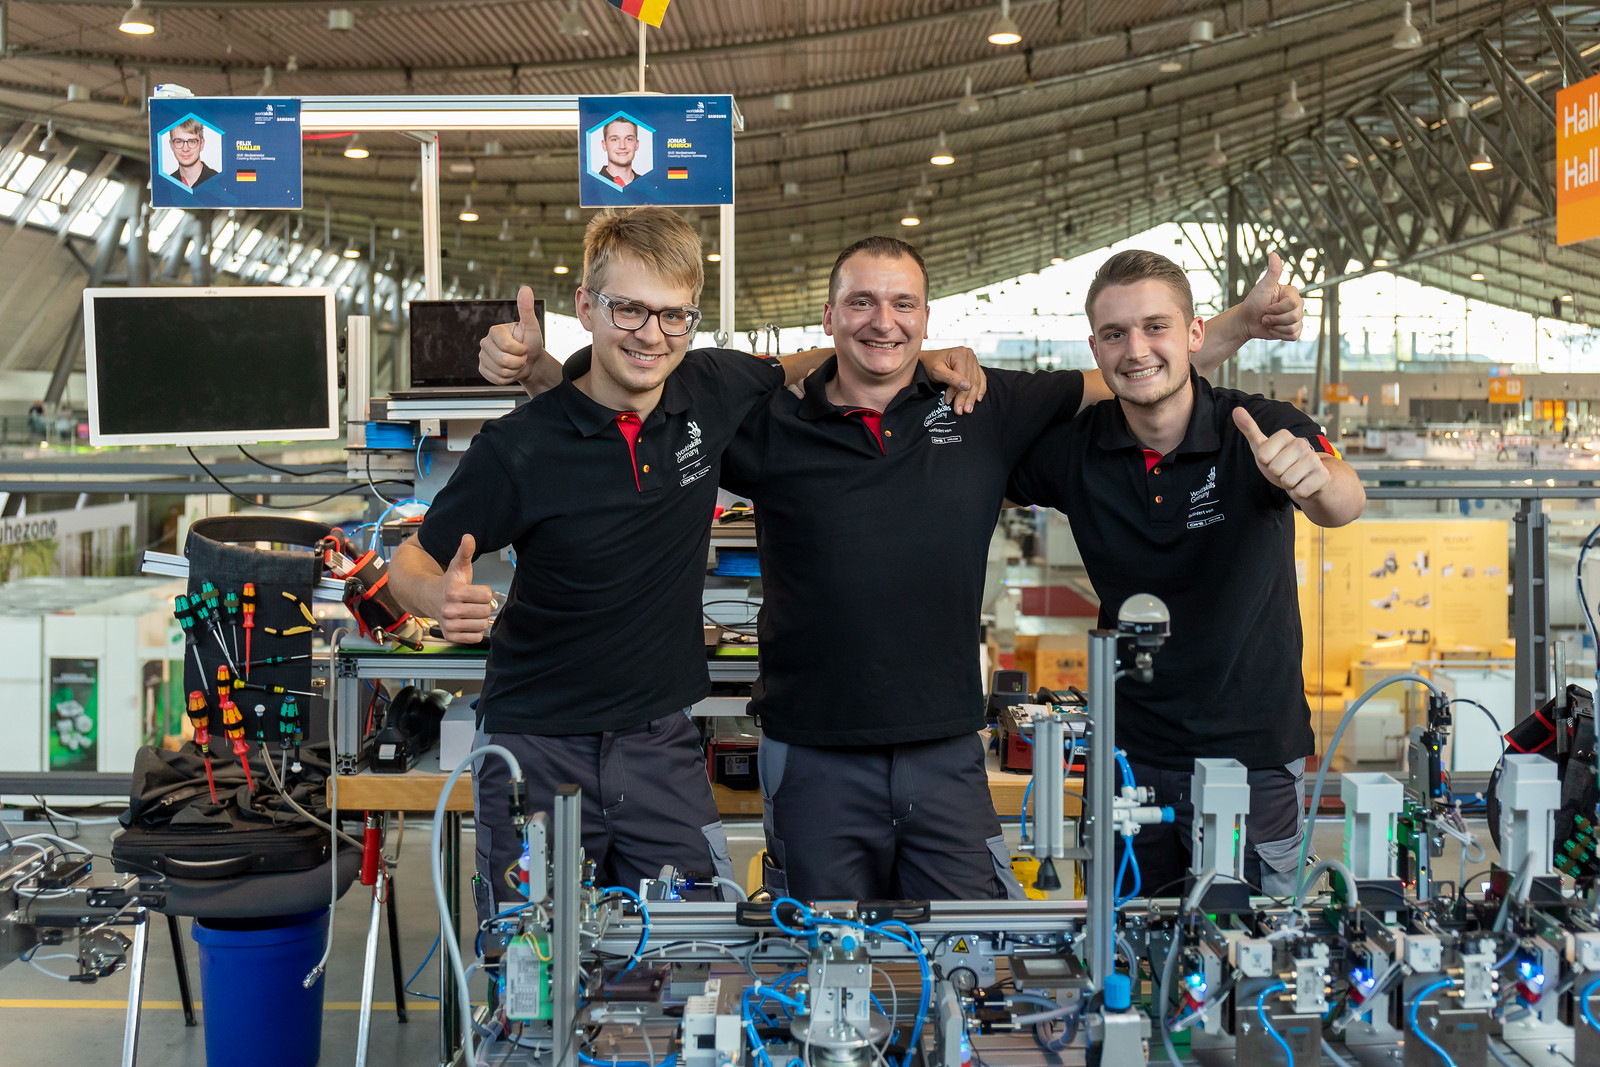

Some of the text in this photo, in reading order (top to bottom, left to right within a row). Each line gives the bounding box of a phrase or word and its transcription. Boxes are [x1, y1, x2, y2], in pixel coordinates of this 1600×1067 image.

[1564, 92, 1600, 138] Hall
[1565, 146, 1598, 191] Hall
[676, 447, 699, 463] Germany
